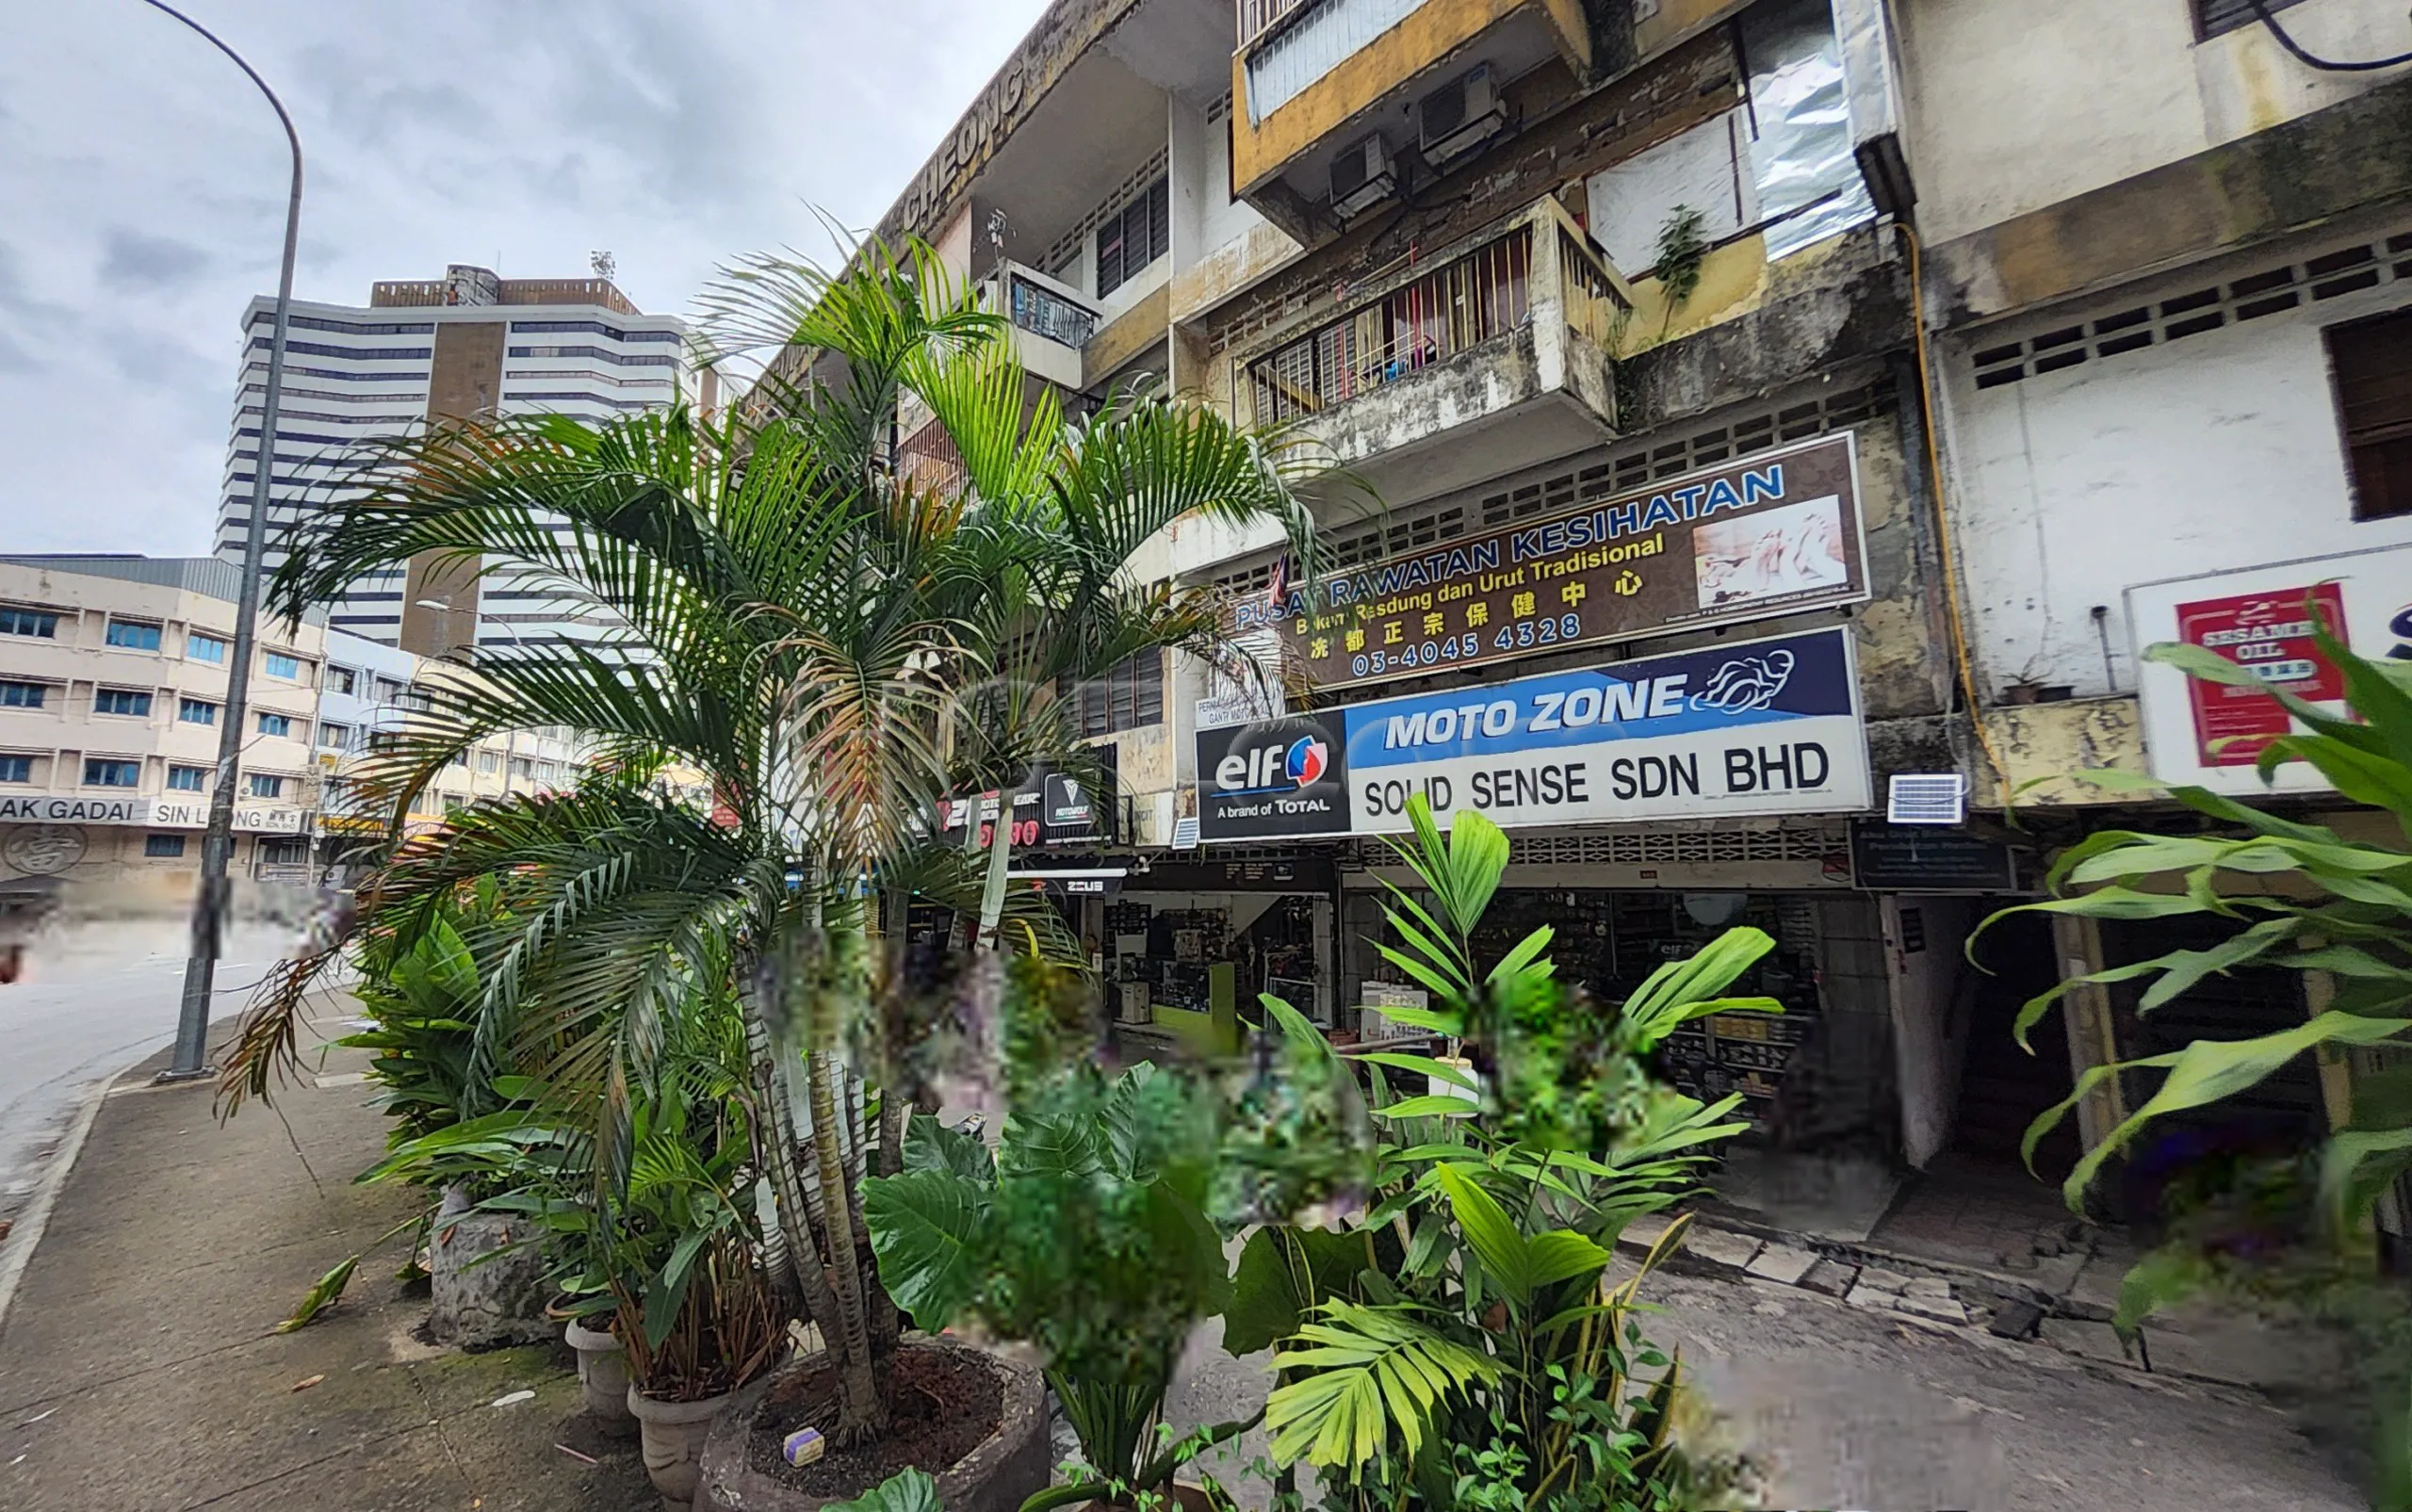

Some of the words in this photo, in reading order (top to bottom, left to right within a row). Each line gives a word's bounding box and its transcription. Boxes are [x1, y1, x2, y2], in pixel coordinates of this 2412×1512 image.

[1235, 584, 1321, 632] PUSA
[1329, 539, 1499, 608] RAWATAN
[1510, 463, 1785, 563] KESIHATAN
[1438, 576, 1473, 603] dan
[1479, 566, 1525, 593] Urut
[1529, 532, 1665, 581] Tradisional
[1352, 632, 1479, 676] 03-4045
[1493, 612, 1581, 650] 4328
[1384, 699, 1518, 751] MOTO
[1527, 673, 1688, 734] ZONE
[1215, 744, 1284, 790] elf
[1472, 763, 1589, 809] SENSE
[1611, 753, 1701, 801] SDN
[1724, 741, 1830, 793] BHD
[48, 801, 133, 821] GADAI
[157, 805, 188, 824] SIN
[196, 806, 261, 828] LNG
[1217, 807, 1227, 819] A
[1228, 804, 1259, 819] brand
[1261, 802, 1272, 816] of
[1275, 799, 1331, 815] TOTAL
[1067, 881, 1103, 892] ZEUS
